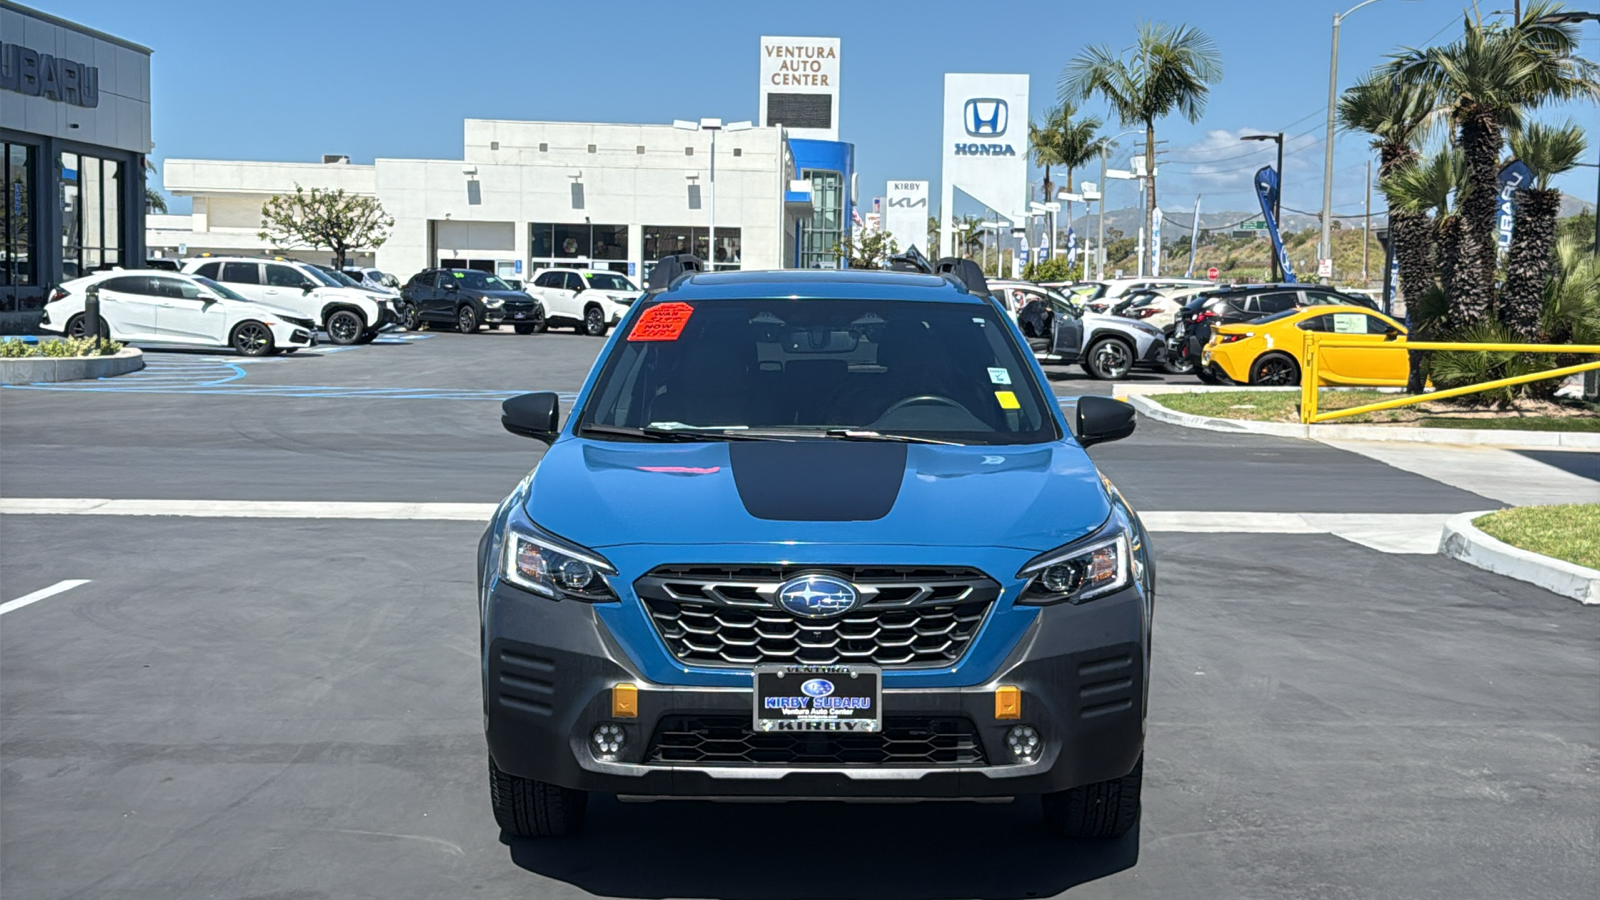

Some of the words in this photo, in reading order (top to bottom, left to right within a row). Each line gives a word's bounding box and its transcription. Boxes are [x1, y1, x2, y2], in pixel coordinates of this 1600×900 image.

[765, 45, 836, 59] VENTURA
[779, 60, 822, 72] AUTO
[771, 72, 829, 86] CENTER
[954, 143, 1016, 156] HONDA
[894, 182, 921, 191] KIRBY
[765, 697, 810, 709] KIRBY
[813, 697, 871, 709] SUBARU
[778, 721, 858, 731] KIRBY
